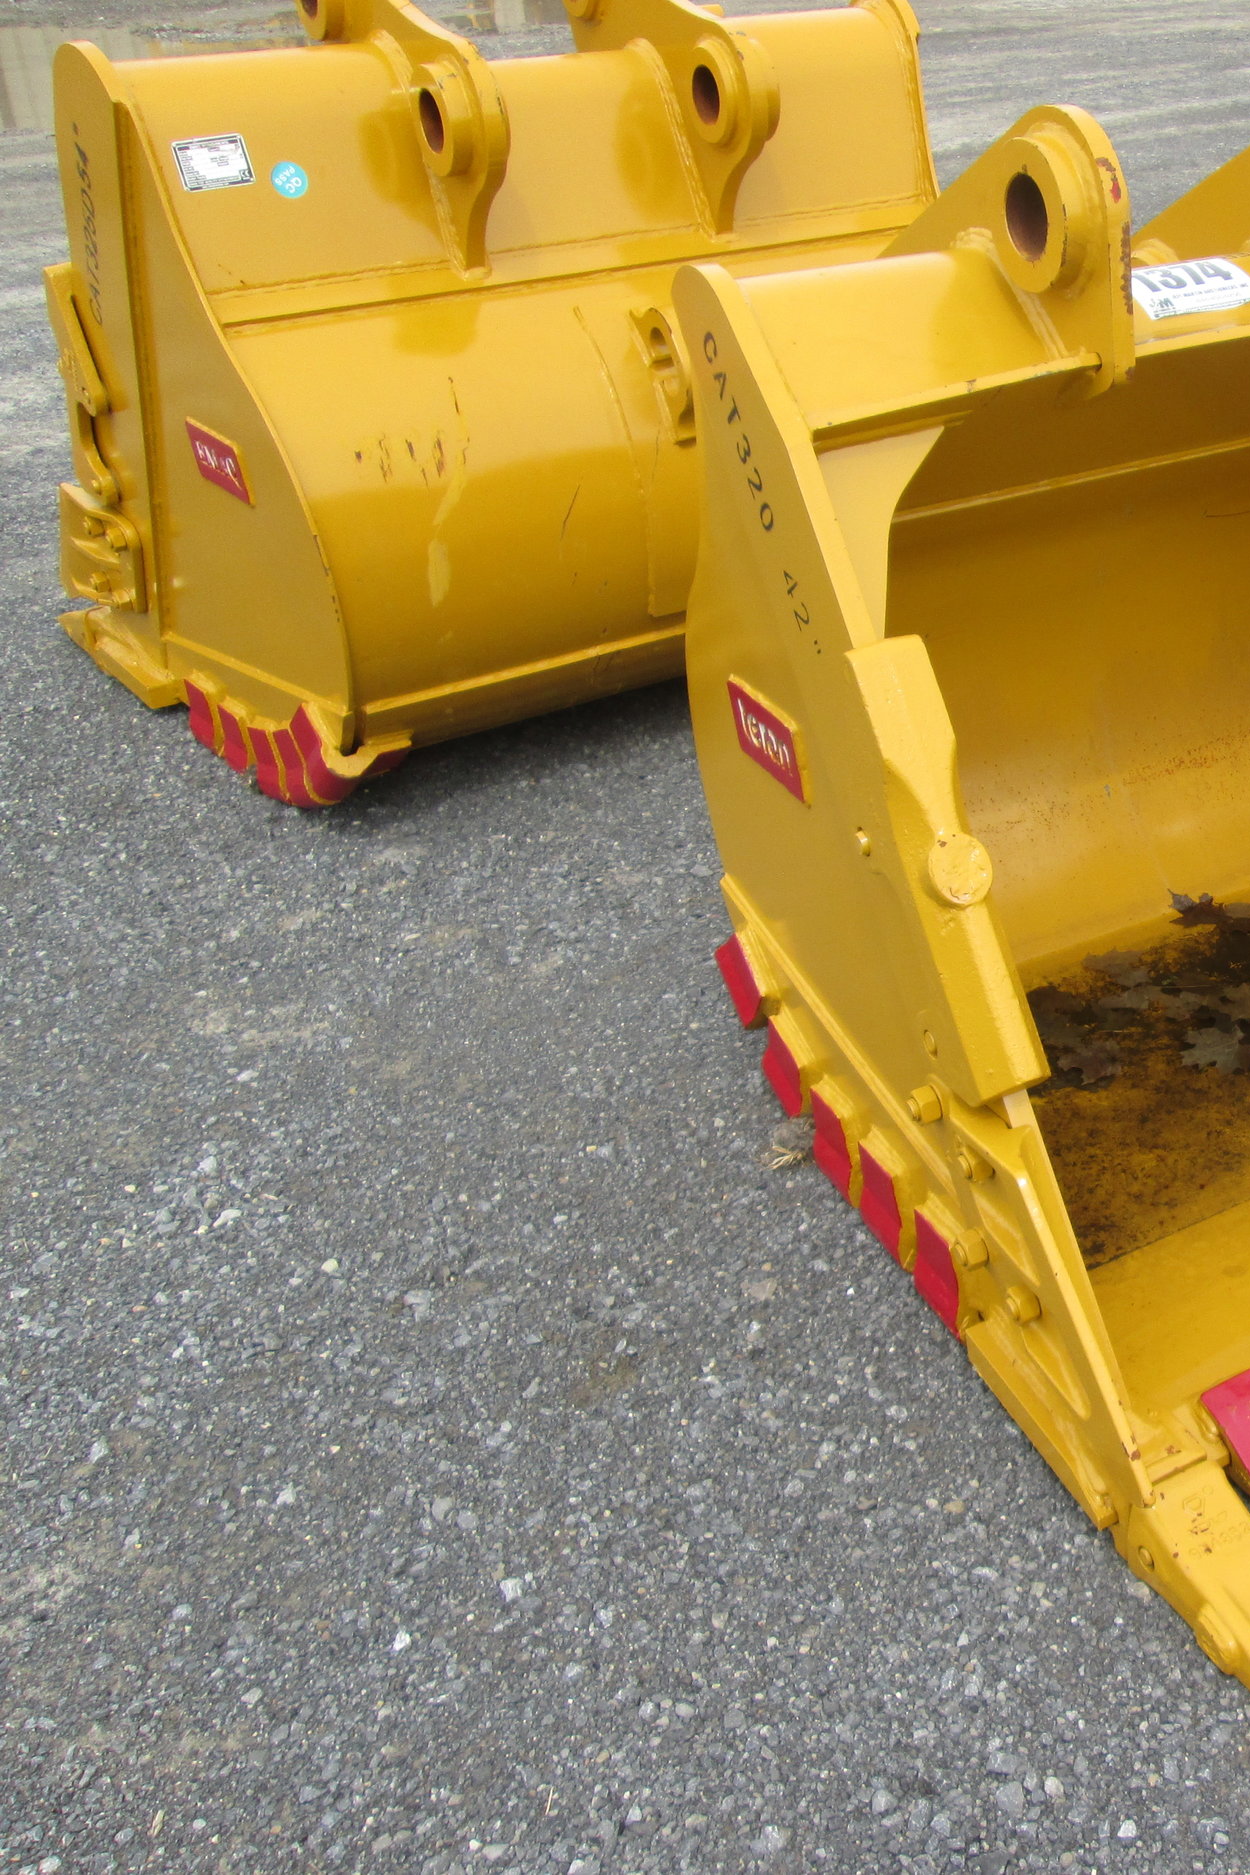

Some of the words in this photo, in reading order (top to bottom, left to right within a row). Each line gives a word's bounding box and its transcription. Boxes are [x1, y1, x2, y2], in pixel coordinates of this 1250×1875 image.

[274, 165, 296, 186] PASS
[285, 176, 303, 194] QC
[1131, 261, 1234, 293] 1374
[703, 331, 774, 532] CAT320
[783, 569, 822, 654] 42"
[737, 698, 793, 777] teran
